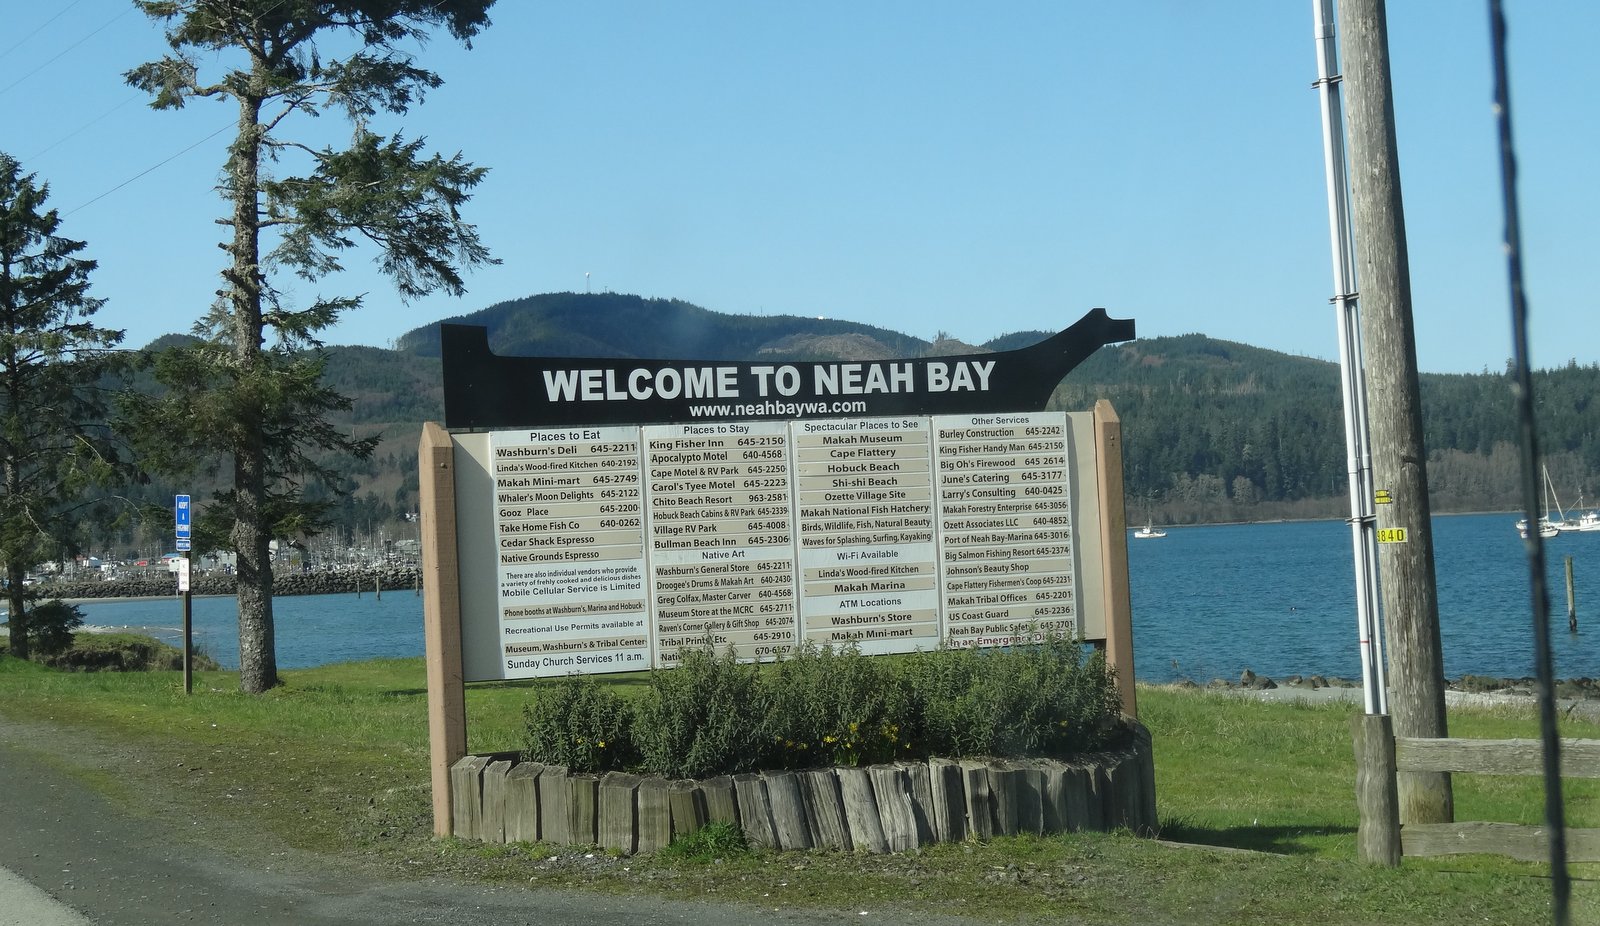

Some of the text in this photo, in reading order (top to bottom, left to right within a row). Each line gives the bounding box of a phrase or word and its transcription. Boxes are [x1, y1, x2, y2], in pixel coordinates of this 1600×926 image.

[542, 361, 996, 402] WELCOME TO NEAH BAY
[689, 398, 866, 418] www.neahbaywa.com
[805, 422, 857, 432] Spectacular
[860, 421, 888, 430] Places
[972, 416, 1029, 425] Other Services
[684, 426, 714, 434] Places
[730, 425, 749, 434] Stay
[940, 427, 1060, 439] Burley Construction 645-2242
[530, 431, 600, 441] Places to Eat
[823, 435, 902, 444] Makah Museum
[650, 441, 672, 450] King
[676, 440, 705, 448] Fisher
[738, 437, 783, 446] 645-2150
[496, 444, 635, 457] Washburn's Deli 645-2211
[830, 448, 896, 459] Cape Flattery
[652, 450, 782, 464] Apocalypto Motel 640-4568
[570, 461, 598, 469] Kitchen
[828, 463, 900, 473] Hobuck Beach
[498, 475, 637, 487] Makah Mini-mart 645-2749
[833, 477, 897, 488] Shi-shi Beach
[942, 471, 1062, 484] June's Catering 645-3177
[652, 479, 786, 492] Carol's Tyee Motel 645-2223
[499, 489, 638, 503] Whaler's Moon Delights 645-2122
[825, 490, 906, 501] Ozette Village Site
[942, 486, 1062, 500] Larry's Consulting 640-0425
[653, 494, 786, 506] Chito Beach Resort 963-2581
[500, 504, 637, 517] Gooz Place 645-2200
[801, 504, 929, 517] Makah National Fish Hatchery
[501, 519, 639, 532] Take Home Fish Co 640-0262
[654, 526, 683, 535] Village
[699, 524, 717, 532] Park
[748, 522, 786, 530] 645-4008
[944, 517, 1067, 529] Ozett Associates LLC 640-4852
[501, 535, 594, 548] Cedar Shack Espresso
[655, 535, 788, 548] Bullman Beach Inn 645-2306
[501, 551, 599, 563] Native Grounds Espresso
[702, 550, 744, 559] Native Art
[837, 550, 898, 560] Wi-Fi Available
[656, 562, 790, 576] Washburn's General Store 645-2211
[819, 566, 918, 578] Linda's Wood-fired Kitchen
[946, 562, 1029, 575] Johnson's Beauty Shop
[503, 588, 530, 597] Mobile
[533, 586, 565, 595] Cellular
[567, 585, 598, 593] Service
[611, 582, 640, 590] Limited
[834, 582, 905, 593] Makah Marina
[840, 598, 901, 608] ATM Locations
[658, 604, 792, 618] Museum Store at the MCRC 645-2711
[949, 606, 1070, 620] US Coast Guard 645-2236
[832, 615, 885, 625] Washburn's
[505, 625, 552, 634] Recreational
[832, 628, 912, 640] Makah Mini-mart
[506, 638, 645, 653] Museum, Washburn's & Tribal Center
[508, 653, 644, 669] Sunday Church Services 11 a.m.
